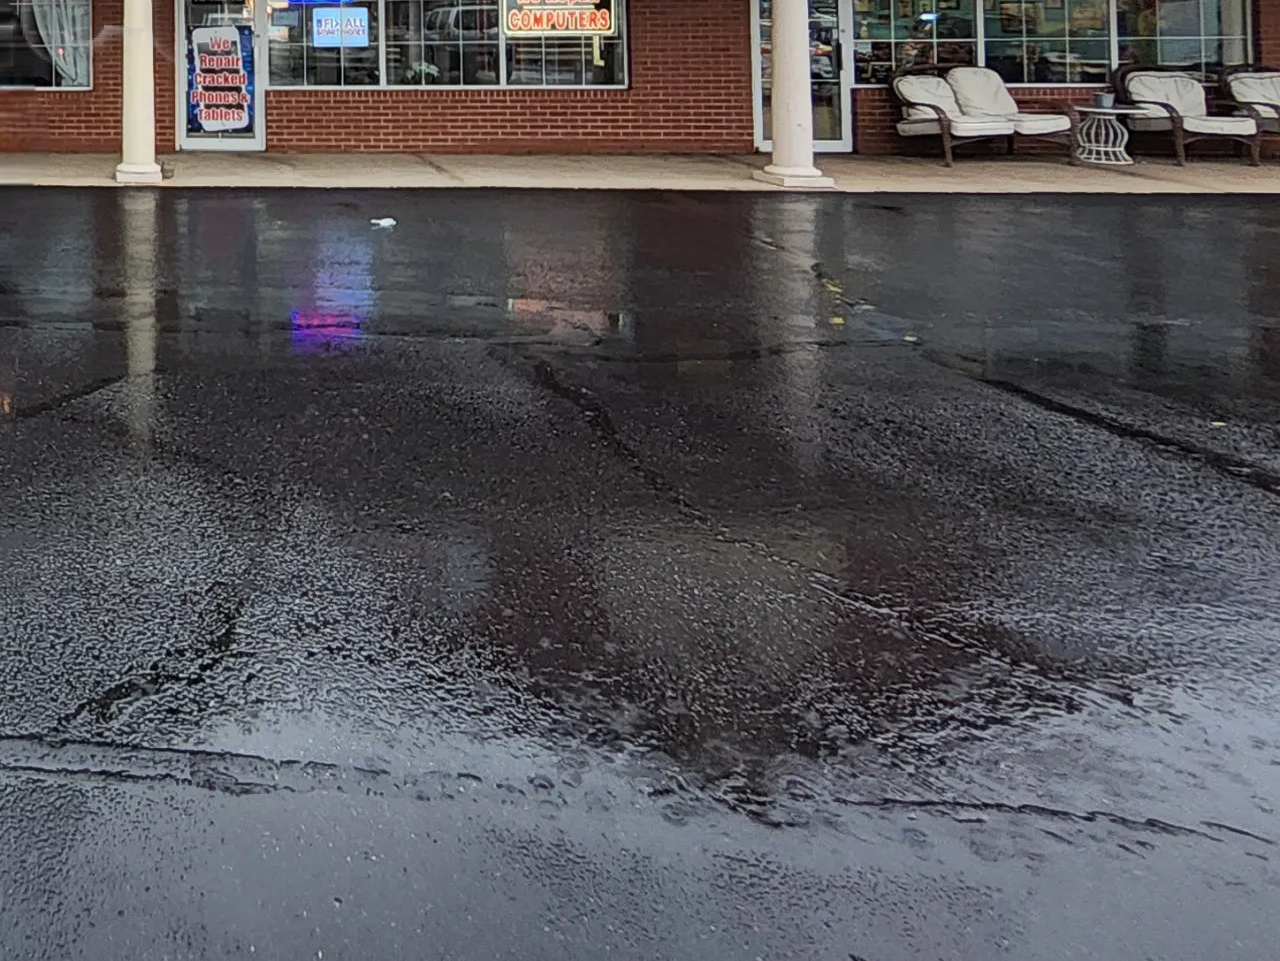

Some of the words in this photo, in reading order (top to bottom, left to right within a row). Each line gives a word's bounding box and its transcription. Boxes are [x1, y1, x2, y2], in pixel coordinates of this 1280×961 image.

[344, 17, 365, 28] ALL
[508, 9, 610, 30] COMPUTERS
[317, 28, 366, 36] SMARTHONES
[210, 37, 231, 50] We
[200, 54, 241, 68] Repair
[194, 72, 247, 86] Cracked
[191, 91, 238, 104] Phones
[198, 109, 244, 122] Tablets
